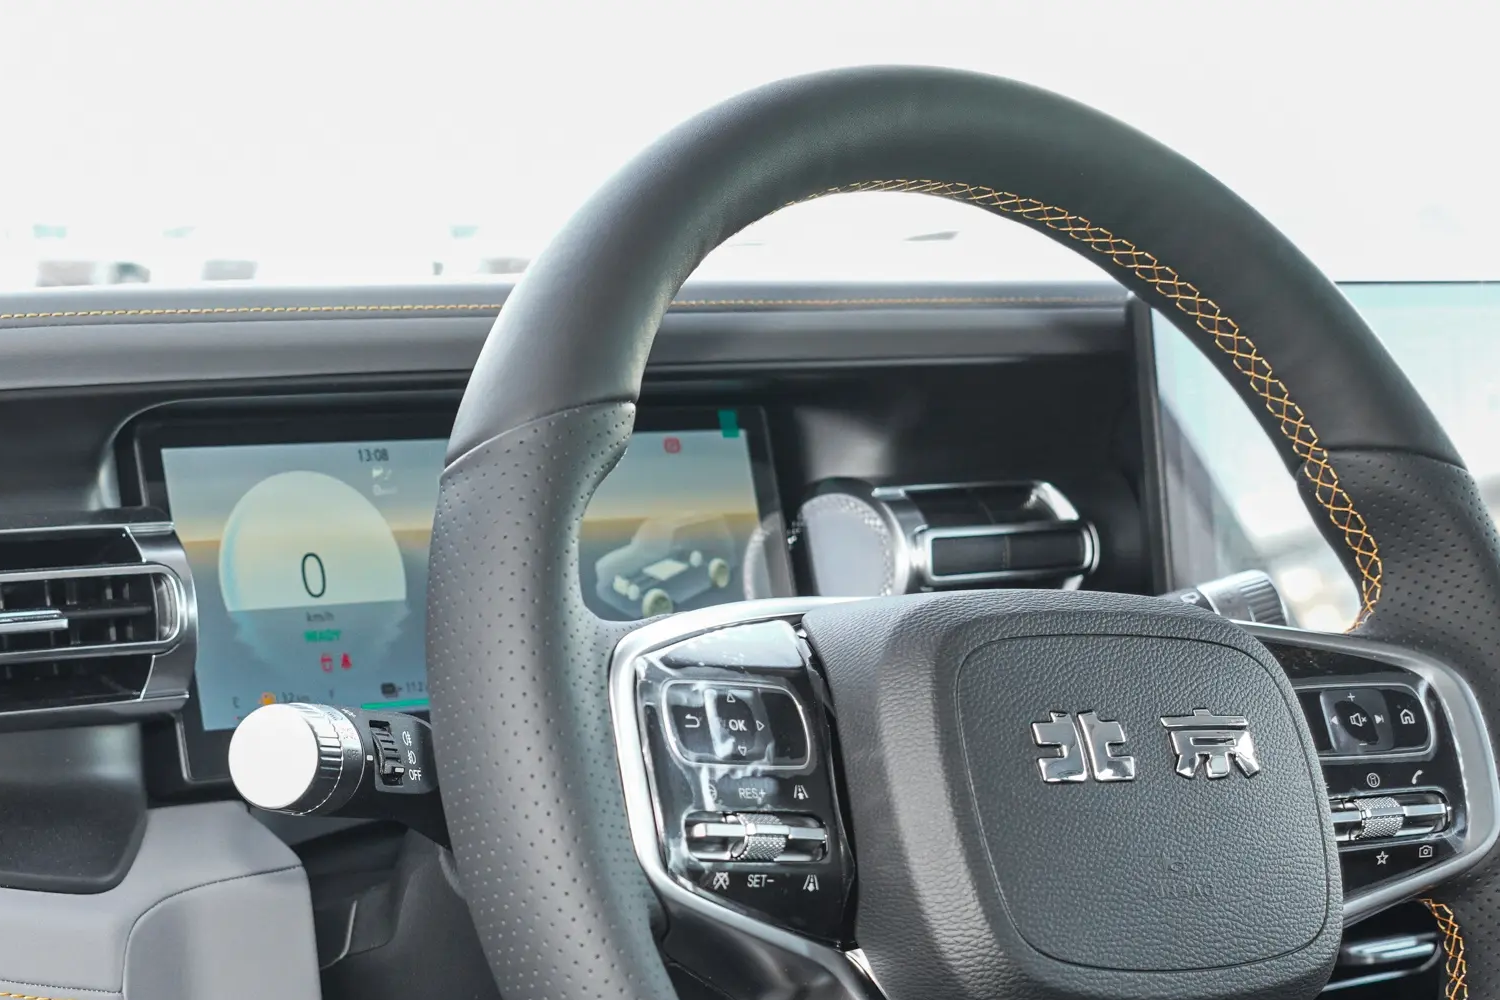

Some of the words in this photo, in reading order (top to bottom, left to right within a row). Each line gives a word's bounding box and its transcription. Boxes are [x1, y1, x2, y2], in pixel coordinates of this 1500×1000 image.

[301, 552, 326, 598] 0
[729, 719, 747, 731] OK
[1030, 707, 1262, 783] 北京
[408, 769, 422, 781] OFF
